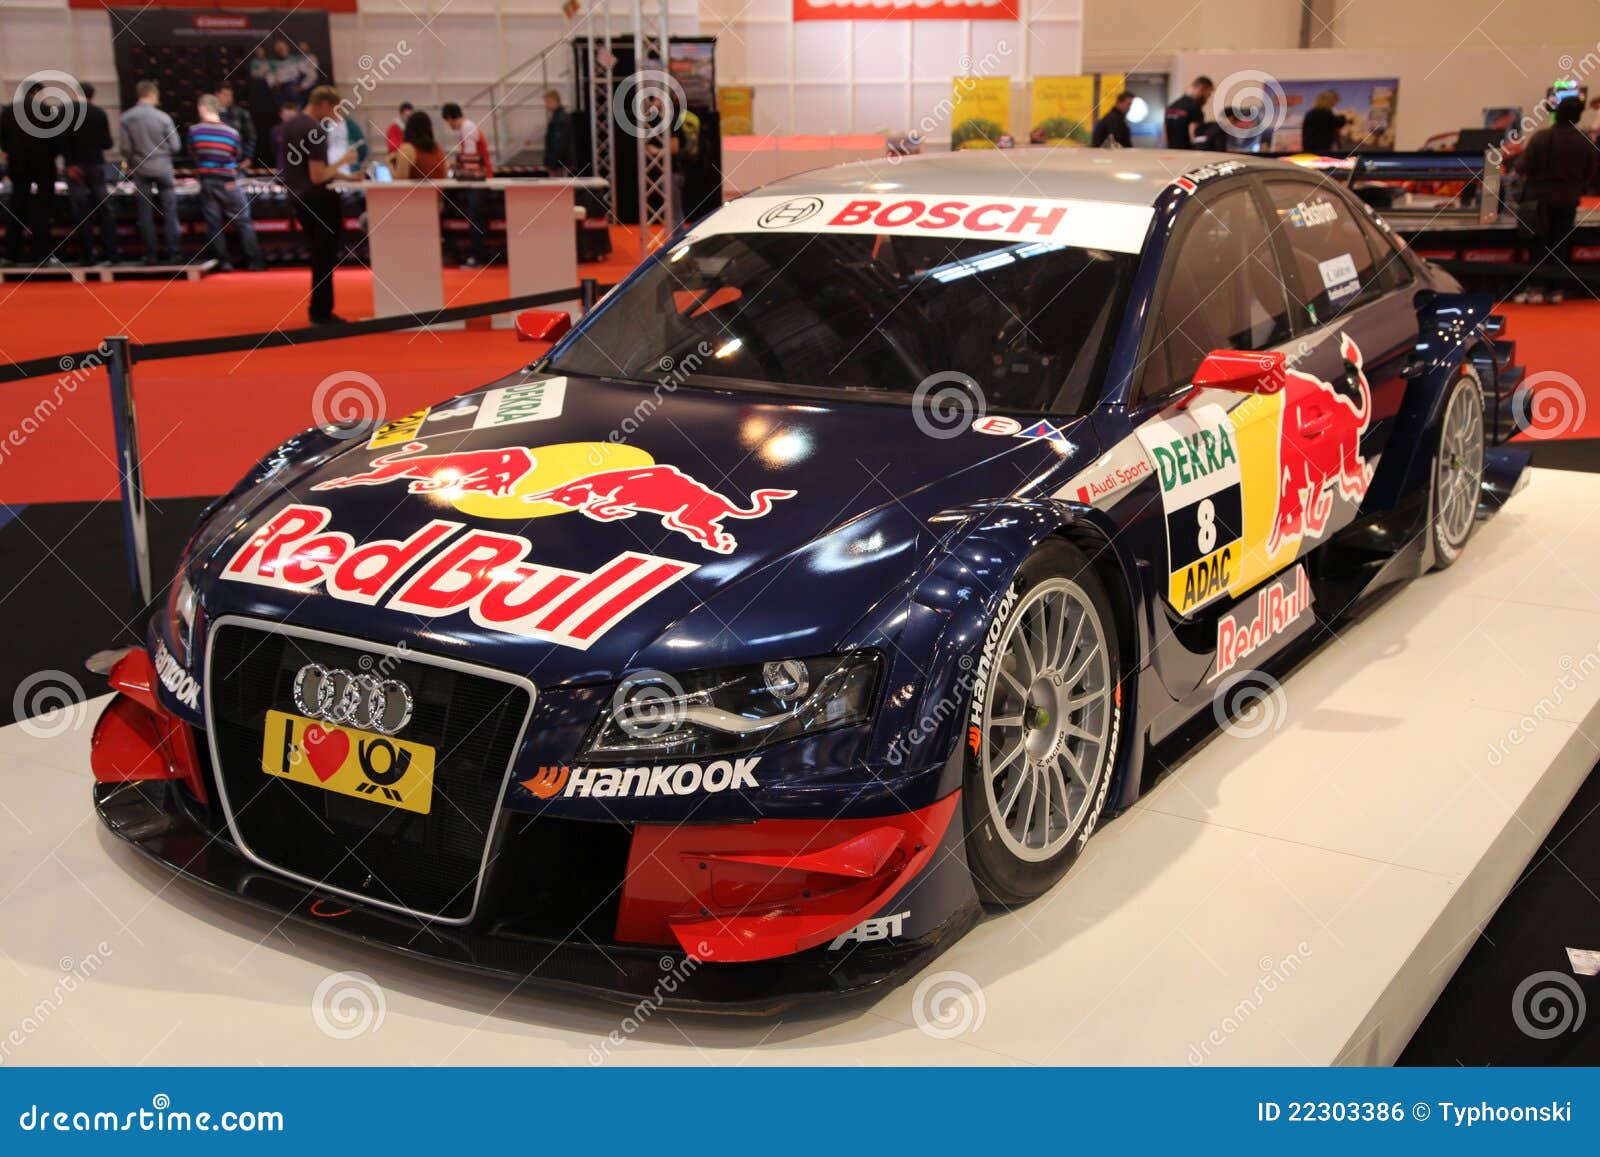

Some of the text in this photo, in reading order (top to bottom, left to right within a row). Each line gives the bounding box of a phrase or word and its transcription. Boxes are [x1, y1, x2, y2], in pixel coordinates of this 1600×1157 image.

[827, 200, 1068, 235] BOSCH
[1091, 460, 1150, 498] Audi Sport
[1153, 424, 1236, 492] DEKRA
[1197, 498, 1217, 555] 8
[226, 506, 692, 645] Red Bull
[1182, 548, 1231, 610] ADAC
[1217, 591, 1267, 674] Red
[1045, 730, 1065, 765] RACING
[827, 910, 911, 951] ABT
